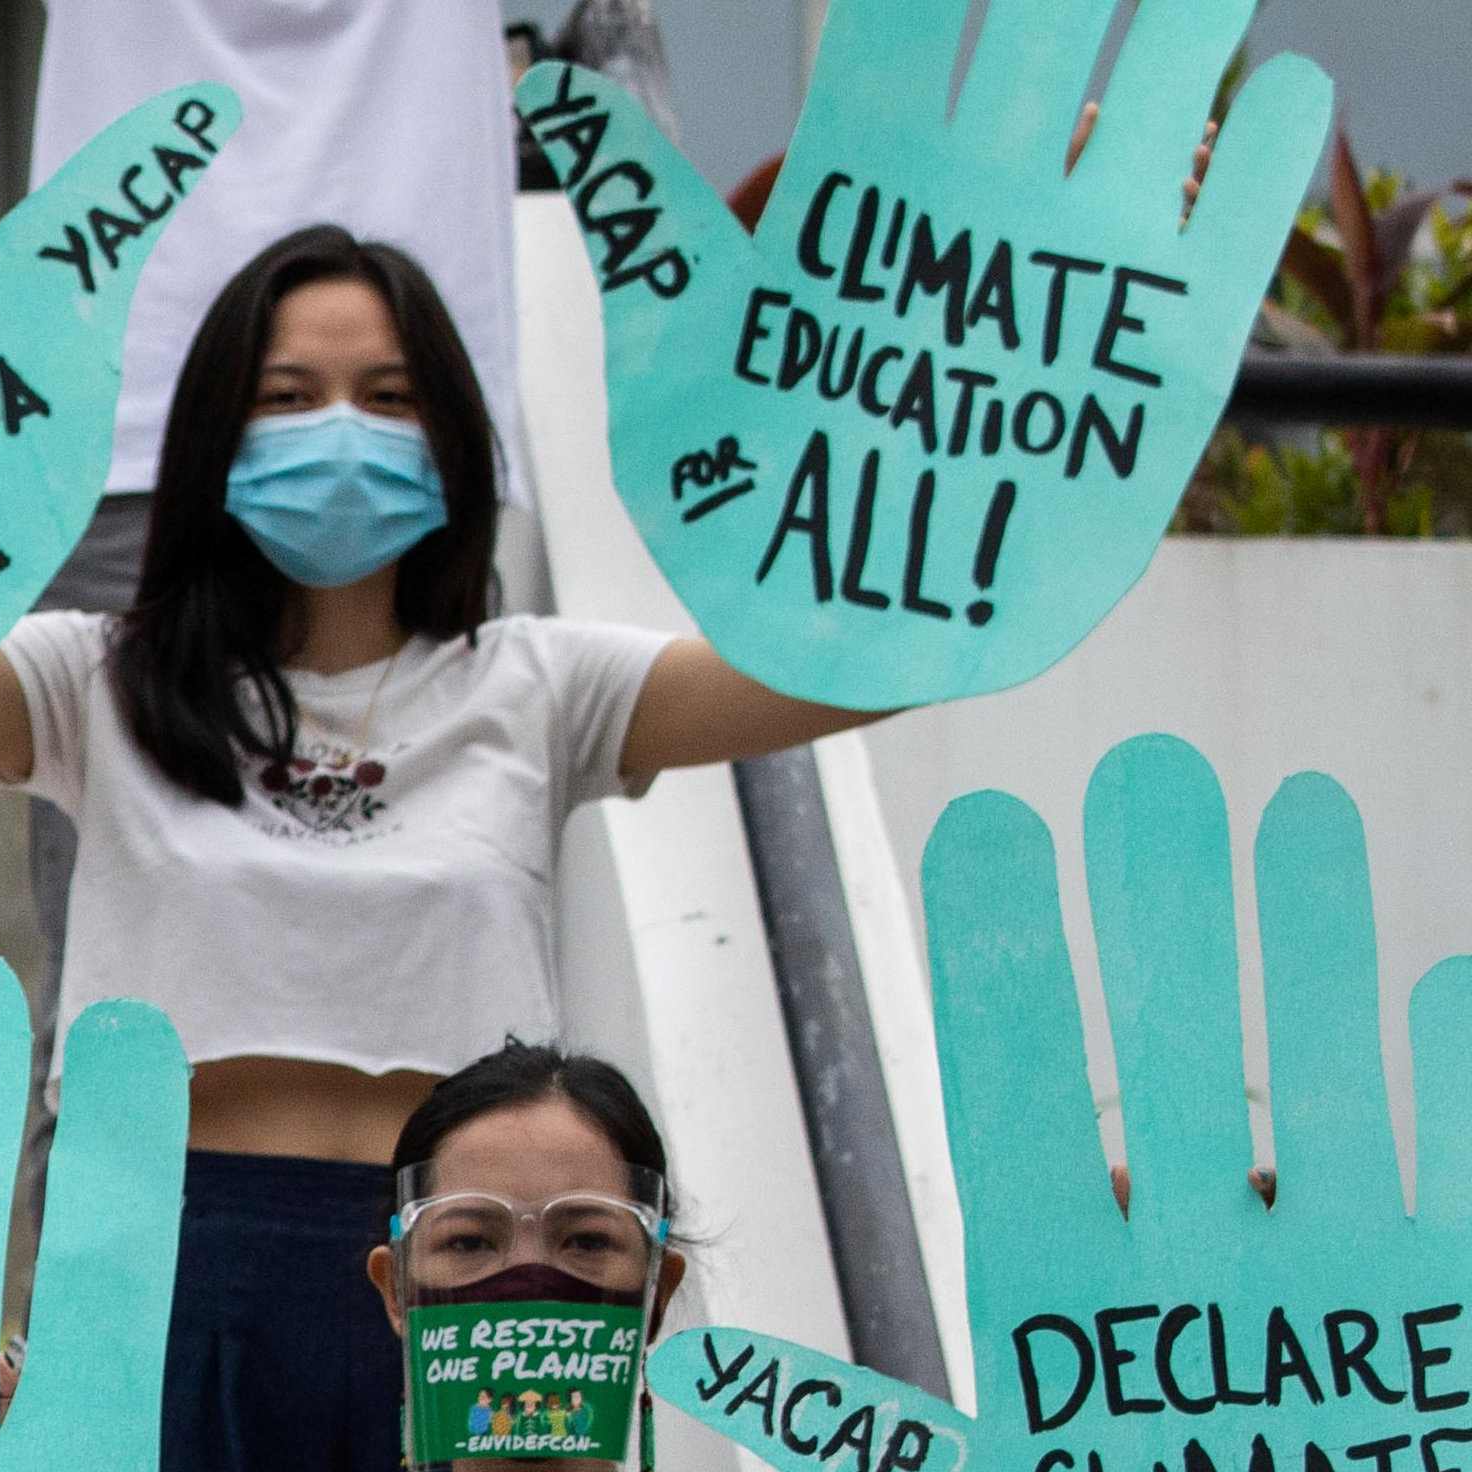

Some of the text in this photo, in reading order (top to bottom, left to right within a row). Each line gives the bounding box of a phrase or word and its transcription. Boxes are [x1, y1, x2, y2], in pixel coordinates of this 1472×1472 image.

[39, 98, 218, 292] YACAP
[526, 65, 690, 299] YACAP
[798, 171, 1188, 387] CLIMATE
[734, 289, 1145, 480] EDUCATION
[672, 429, 1016, 626] FOR ALL!
[421, 1318, 637, 1351] WE RESIST AS
[426, 1350, 632, 1385] ONE PLANET!
[1012, 1303, 1470, 1435] DECLARE
